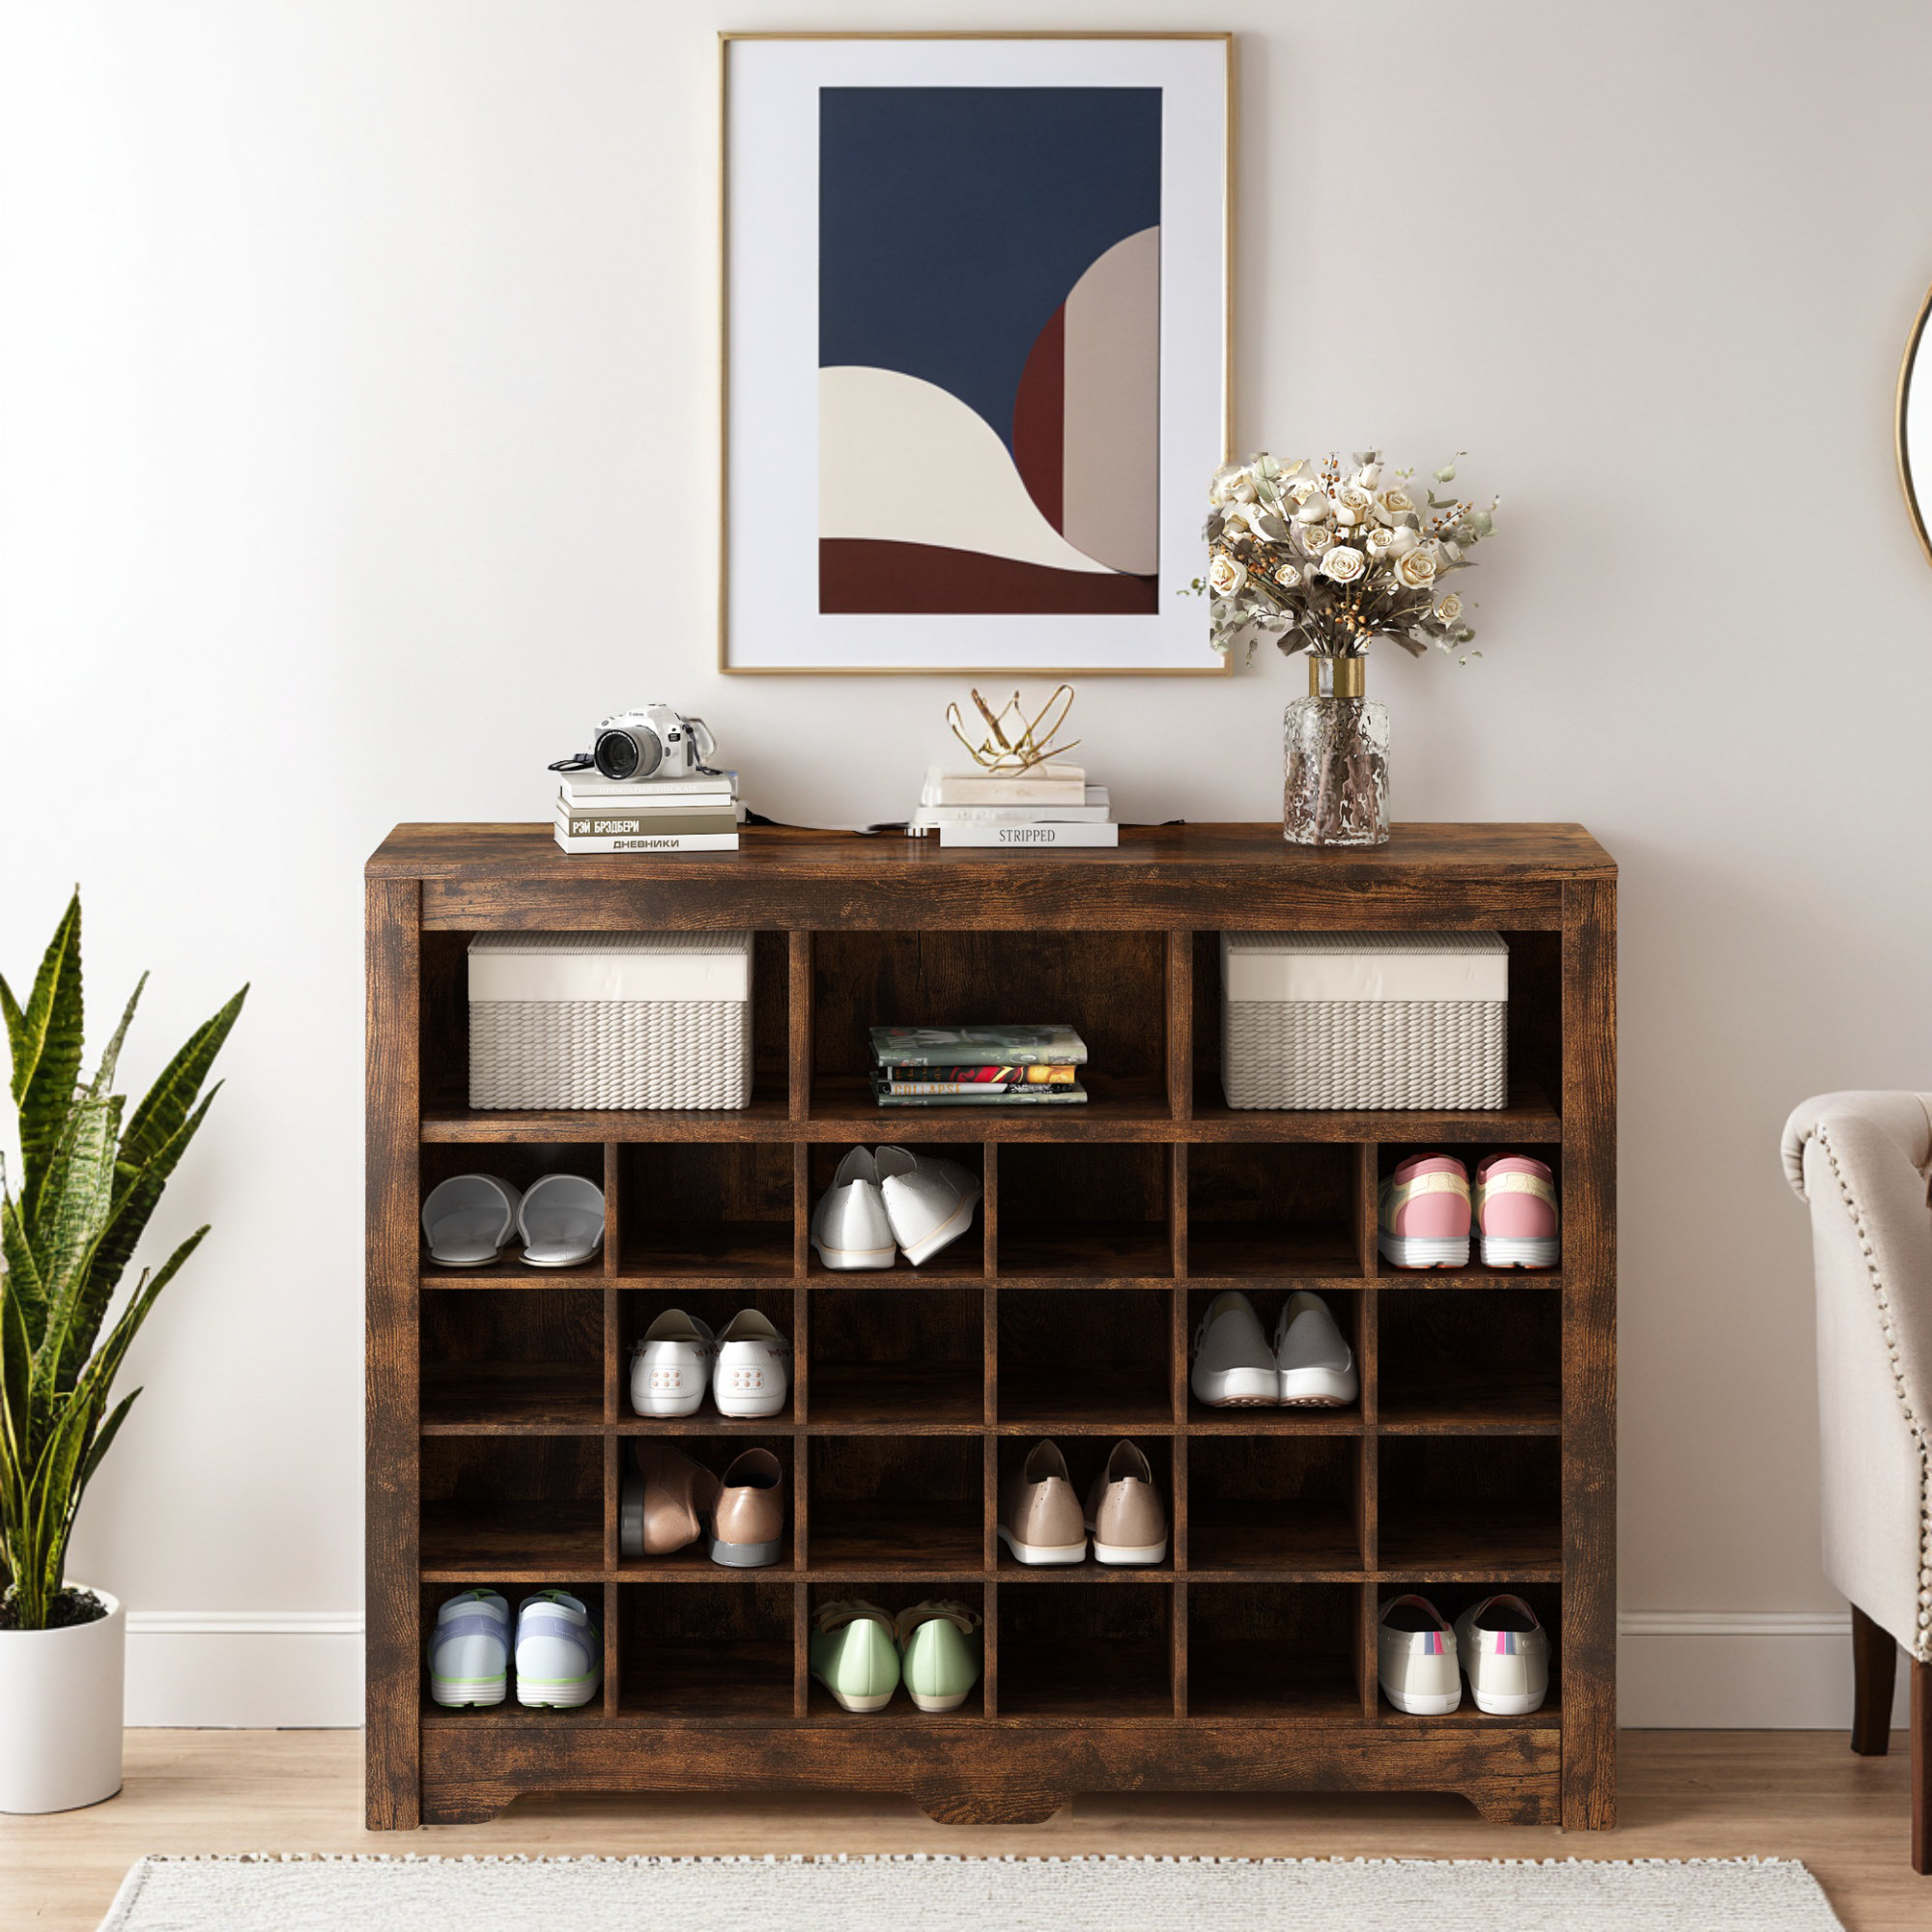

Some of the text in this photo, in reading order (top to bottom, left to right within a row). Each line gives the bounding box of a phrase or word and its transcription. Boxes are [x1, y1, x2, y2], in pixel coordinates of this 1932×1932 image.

[572, 819, 639, 834] РЭЙ БРЭДБЕРИ
[999, 829, 1056, 842] STRIPPED
[612, 839, 680, 849] ДНЕВНИКИ
[894, 1083, 963, 1095] COLLAPSE
